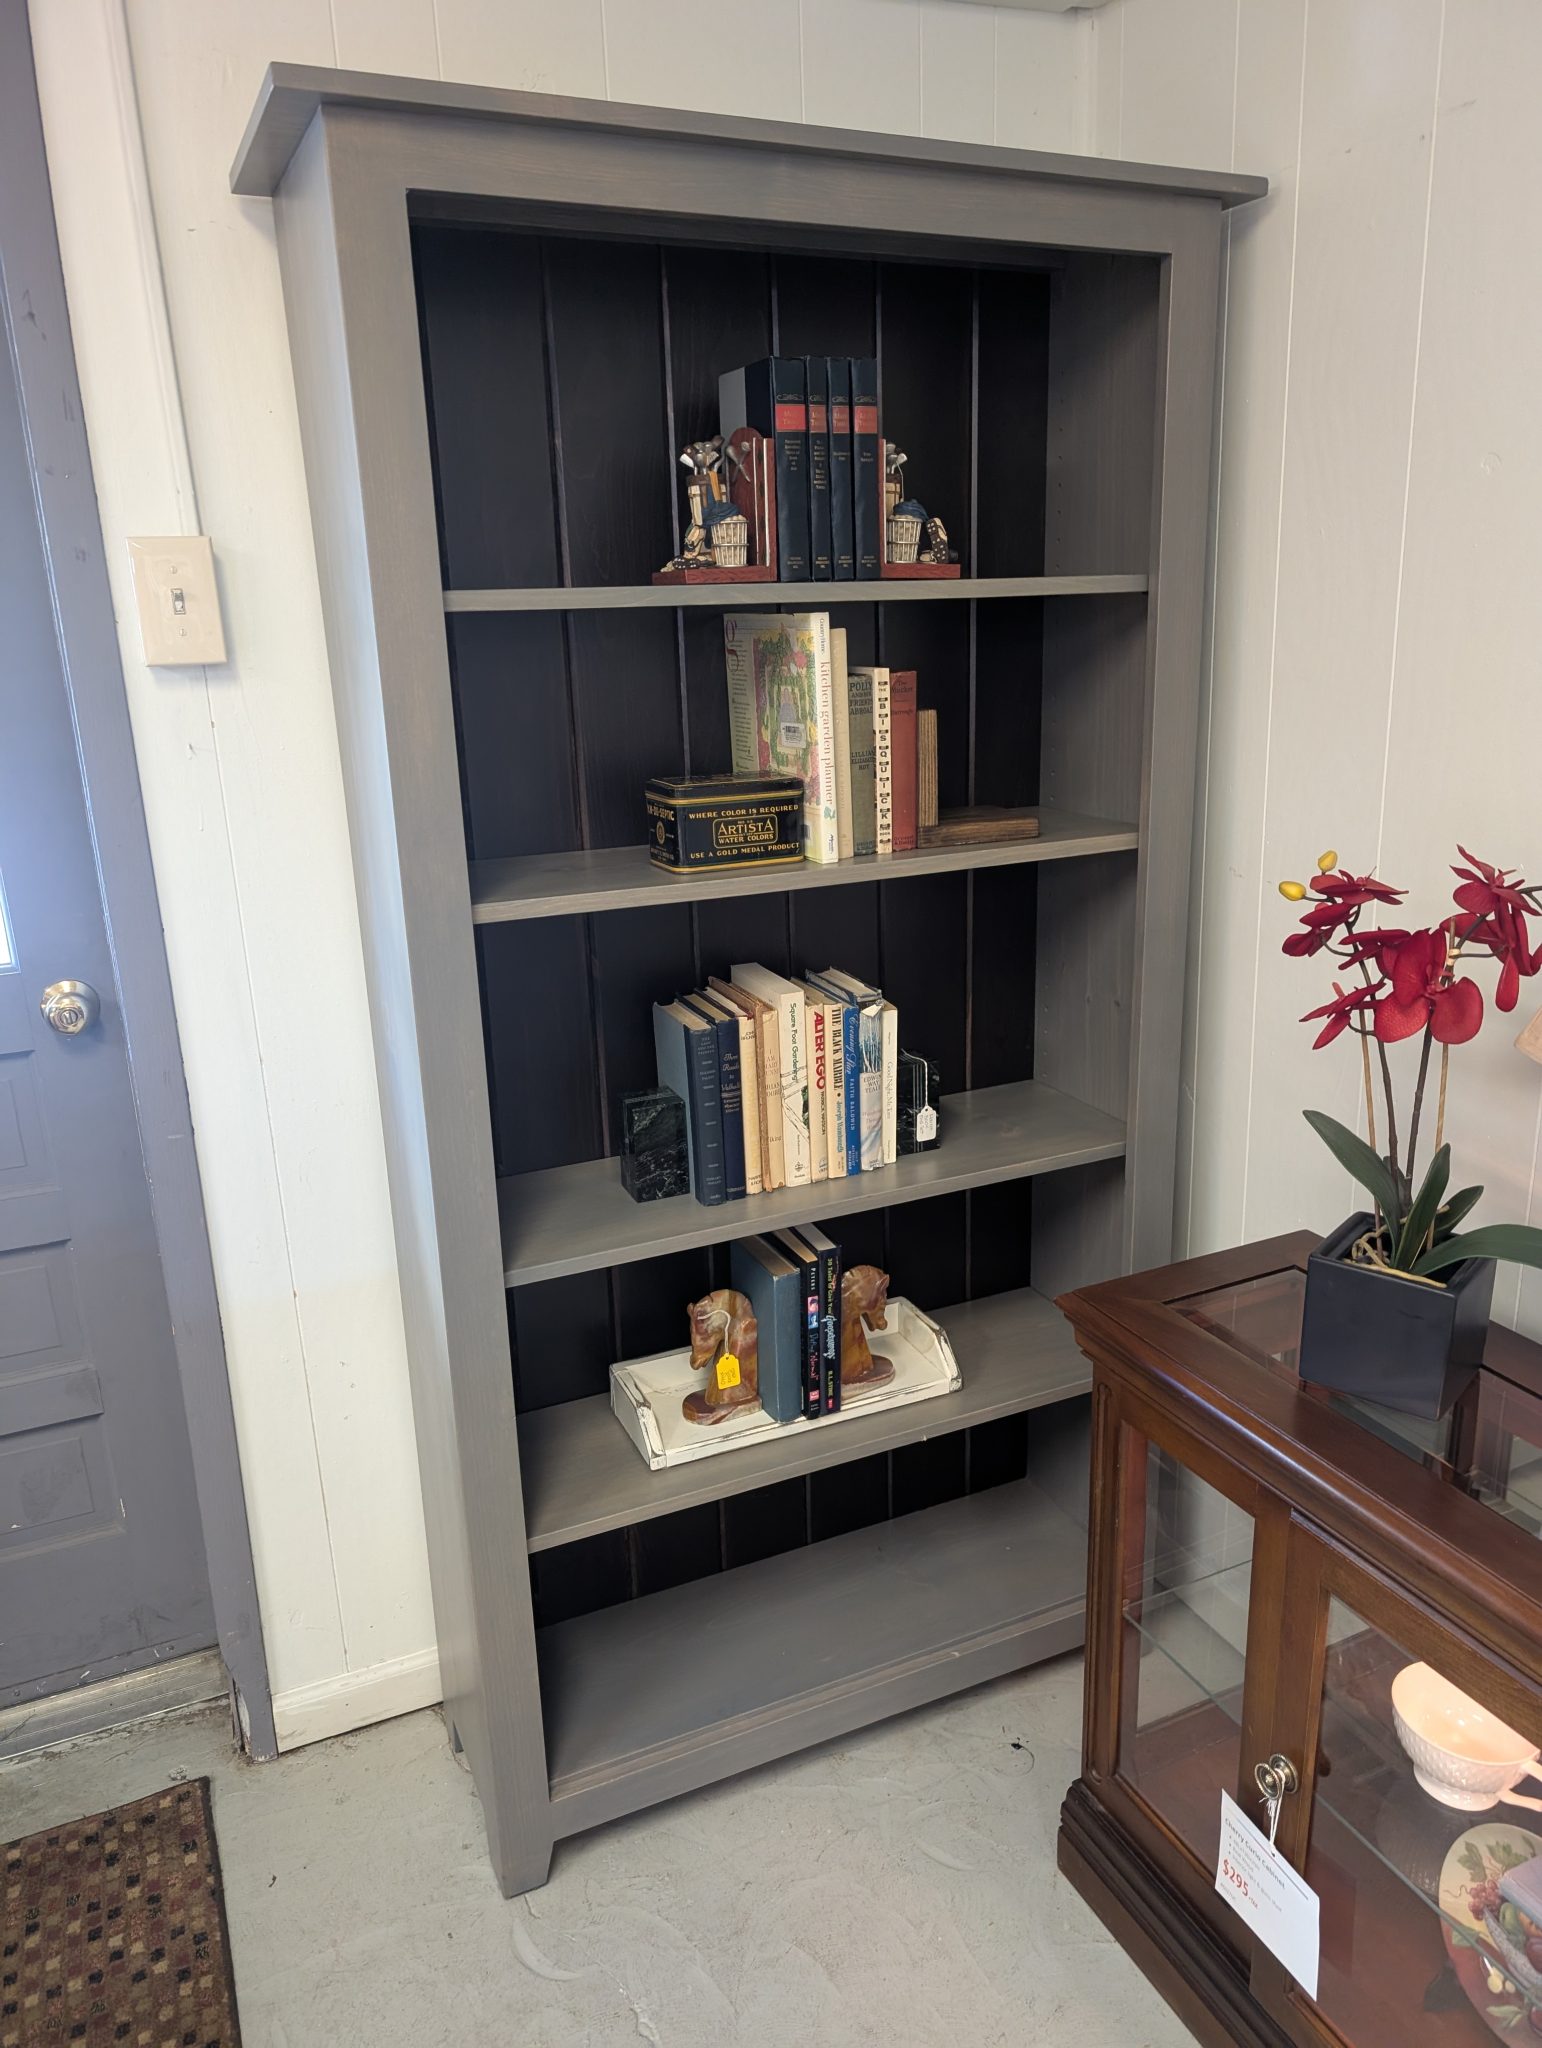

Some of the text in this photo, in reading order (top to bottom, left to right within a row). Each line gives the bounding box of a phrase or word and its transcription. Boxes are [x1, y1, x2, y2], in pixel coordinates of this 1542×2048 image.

[849, 682, 873, 692] POLLY
[820, 661, 834, 804] kitchen garden planner
[689, 811, 718, 819] WHERE
[721, 809, 747, 817] COLOR
[759, 804, 799, 814] REQUIRED
[718, 818, 774, 836] ARTISTA
[717, 848, 738, 856] GOLD
[741, 845, 765, 853] MEDAL
[768, 842, 800, 851] PRODUCT
[718, 833, 774, 844] WATER COLORS
[789, 1003, 797, 1028] Square
[814, 1011, 824, 1053] ALTER
[846, 1013, 859, 1053] Evening
[831, 1008, 843, 1090] THE BLACK MARBLE
[846, 1053, 857, 1075] Star
[815, 1055, 826, 1090] EGO
[821, 1315, 837, 1360] Goosebumps
[1225, 1818, 1244, 1843] Cherry
[1261, 1859, 1285, 1889] Cabinet
[1223, 1858, 1249, 1897] $295
